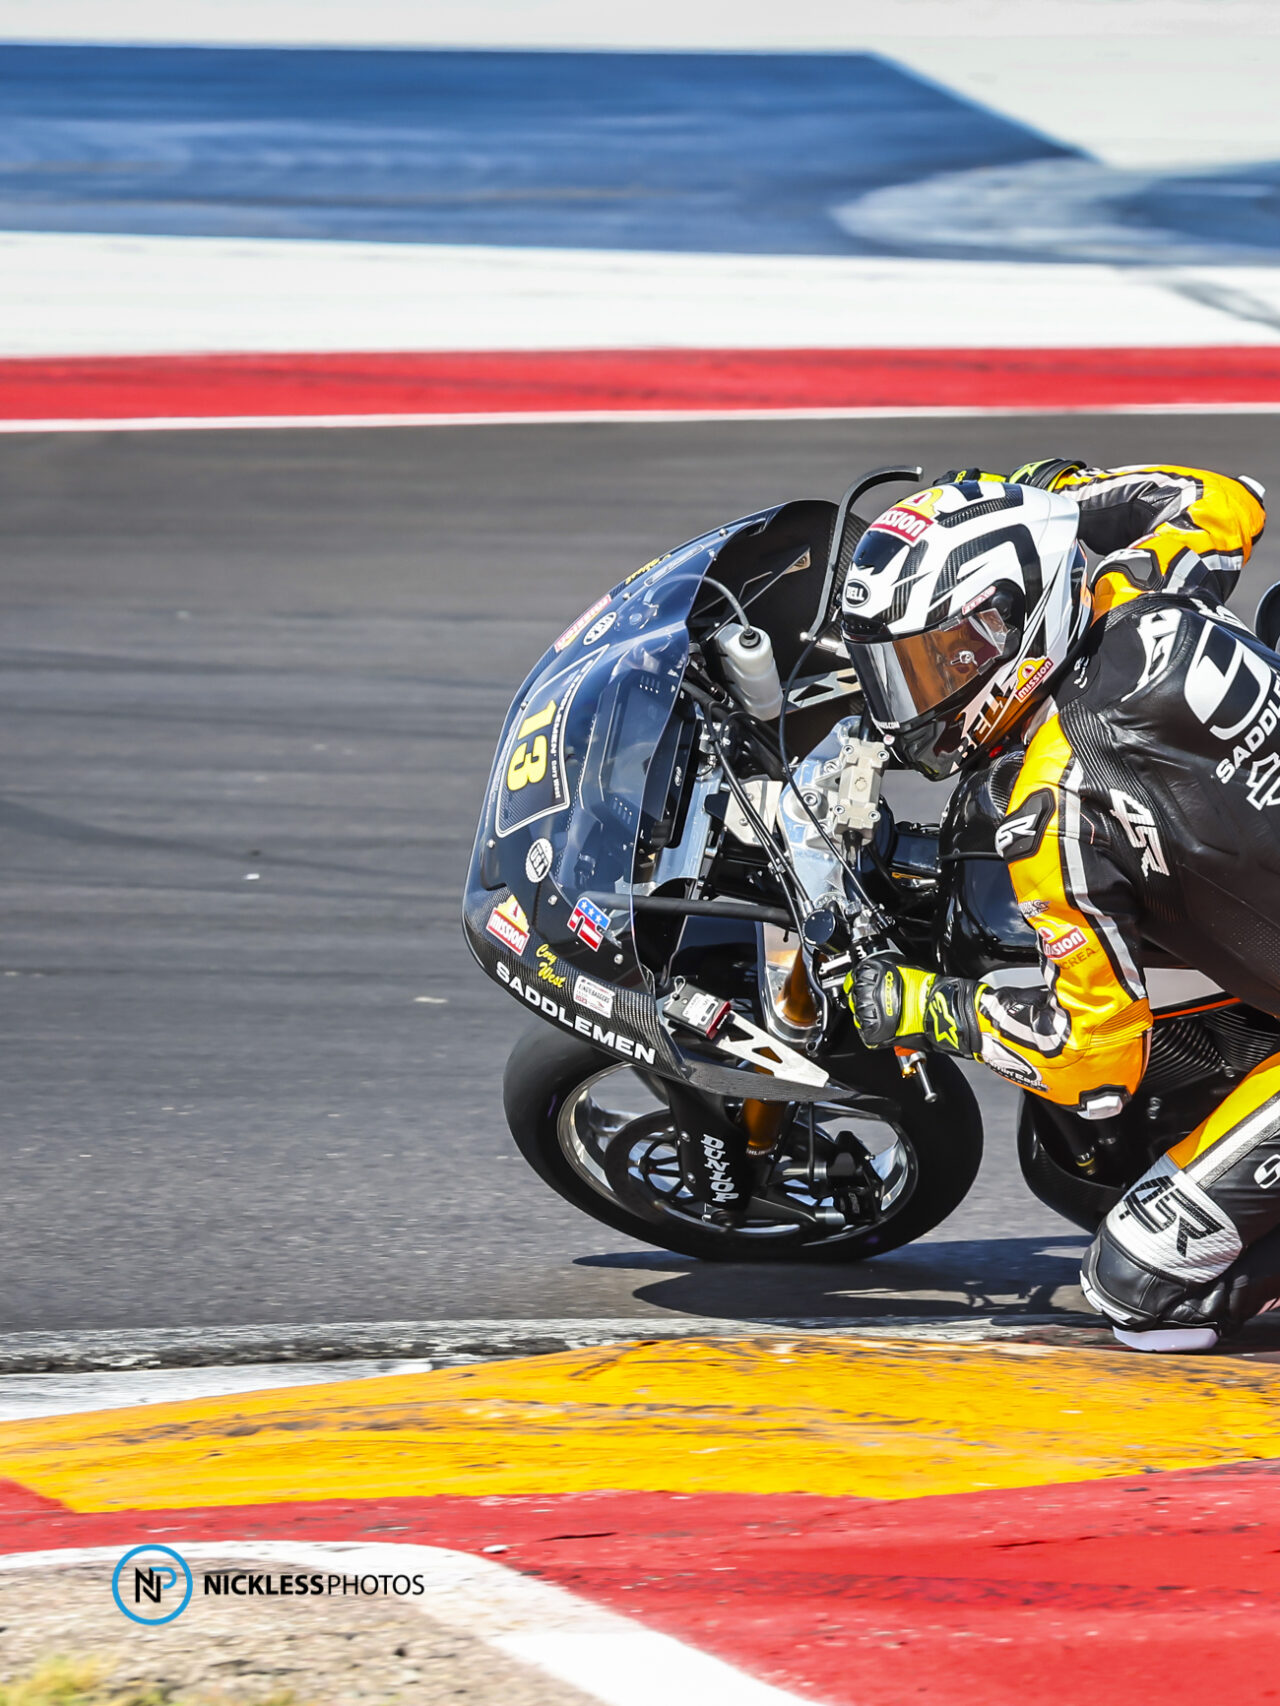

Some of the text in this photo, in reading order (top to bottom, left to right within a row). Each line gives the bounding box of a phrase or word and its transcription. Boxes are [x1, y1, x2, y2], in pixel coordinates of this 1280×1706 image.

[846, 585, 865, 601] BELL
[507, 699, 557, 791] 13
[536, 944, 557, 964] Cory
[537, 962, 566, 989] West
[496, 961, 656, 1065] SADDLEMEN
[700, 1133, 740, 1203] DUNLOP
